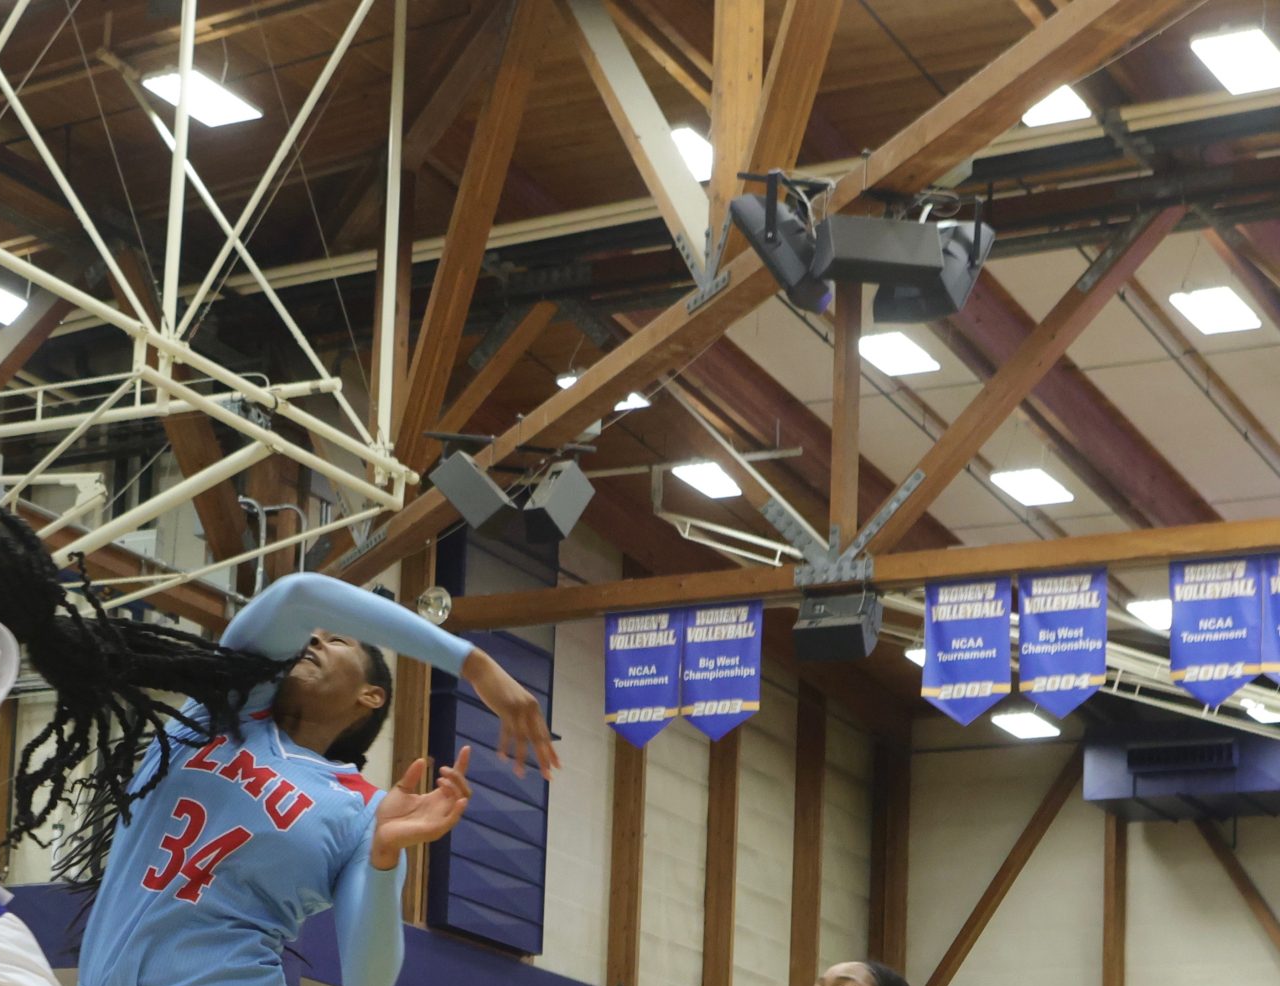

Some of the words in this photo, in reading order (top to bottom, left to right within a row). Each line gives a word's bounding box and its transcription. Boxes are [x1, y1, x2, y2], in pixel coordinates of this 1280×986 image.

[1175, 578, 1257, 601] VOLLEYBALL
[932, 600, 1005, 622] VOLLEYBALL
[1024, 591, 1101, 615] VOLLEYBALL
[1199, 616, 1233, 630] NCAA
[609, 630, 676, 650] VOLLEYBALL
[687, 622, 756, 643] VOLLEYBALL
[1039, 630, 1056, 642] Big
[1057, 627, 1084, 639] West
[1181, 628, 1247, 643] Tournament
[951, 637, 984, 650] NCAA
[1022, 639, 1103, 655] Championships
[699, 657, 715, 669] Big
[716, 656, 740, 667] West
[937, 648, 997, 663] Tournament
[628, 664, 657, 677] NCAA
[683, 666, 756, 681] Championships
[1183, 662, 1245, 683] 2004
[613, 676, 669, 689] Tournament
[938, 681, 994, 699] 2003
[1032, 673, 1091, 693] 2004
[615, 707, 667, 724] 2002
[692, 699, 743, 717] 2003
[181, 734, 317, 833] LMU
[140, 797, 255, 905] 34
